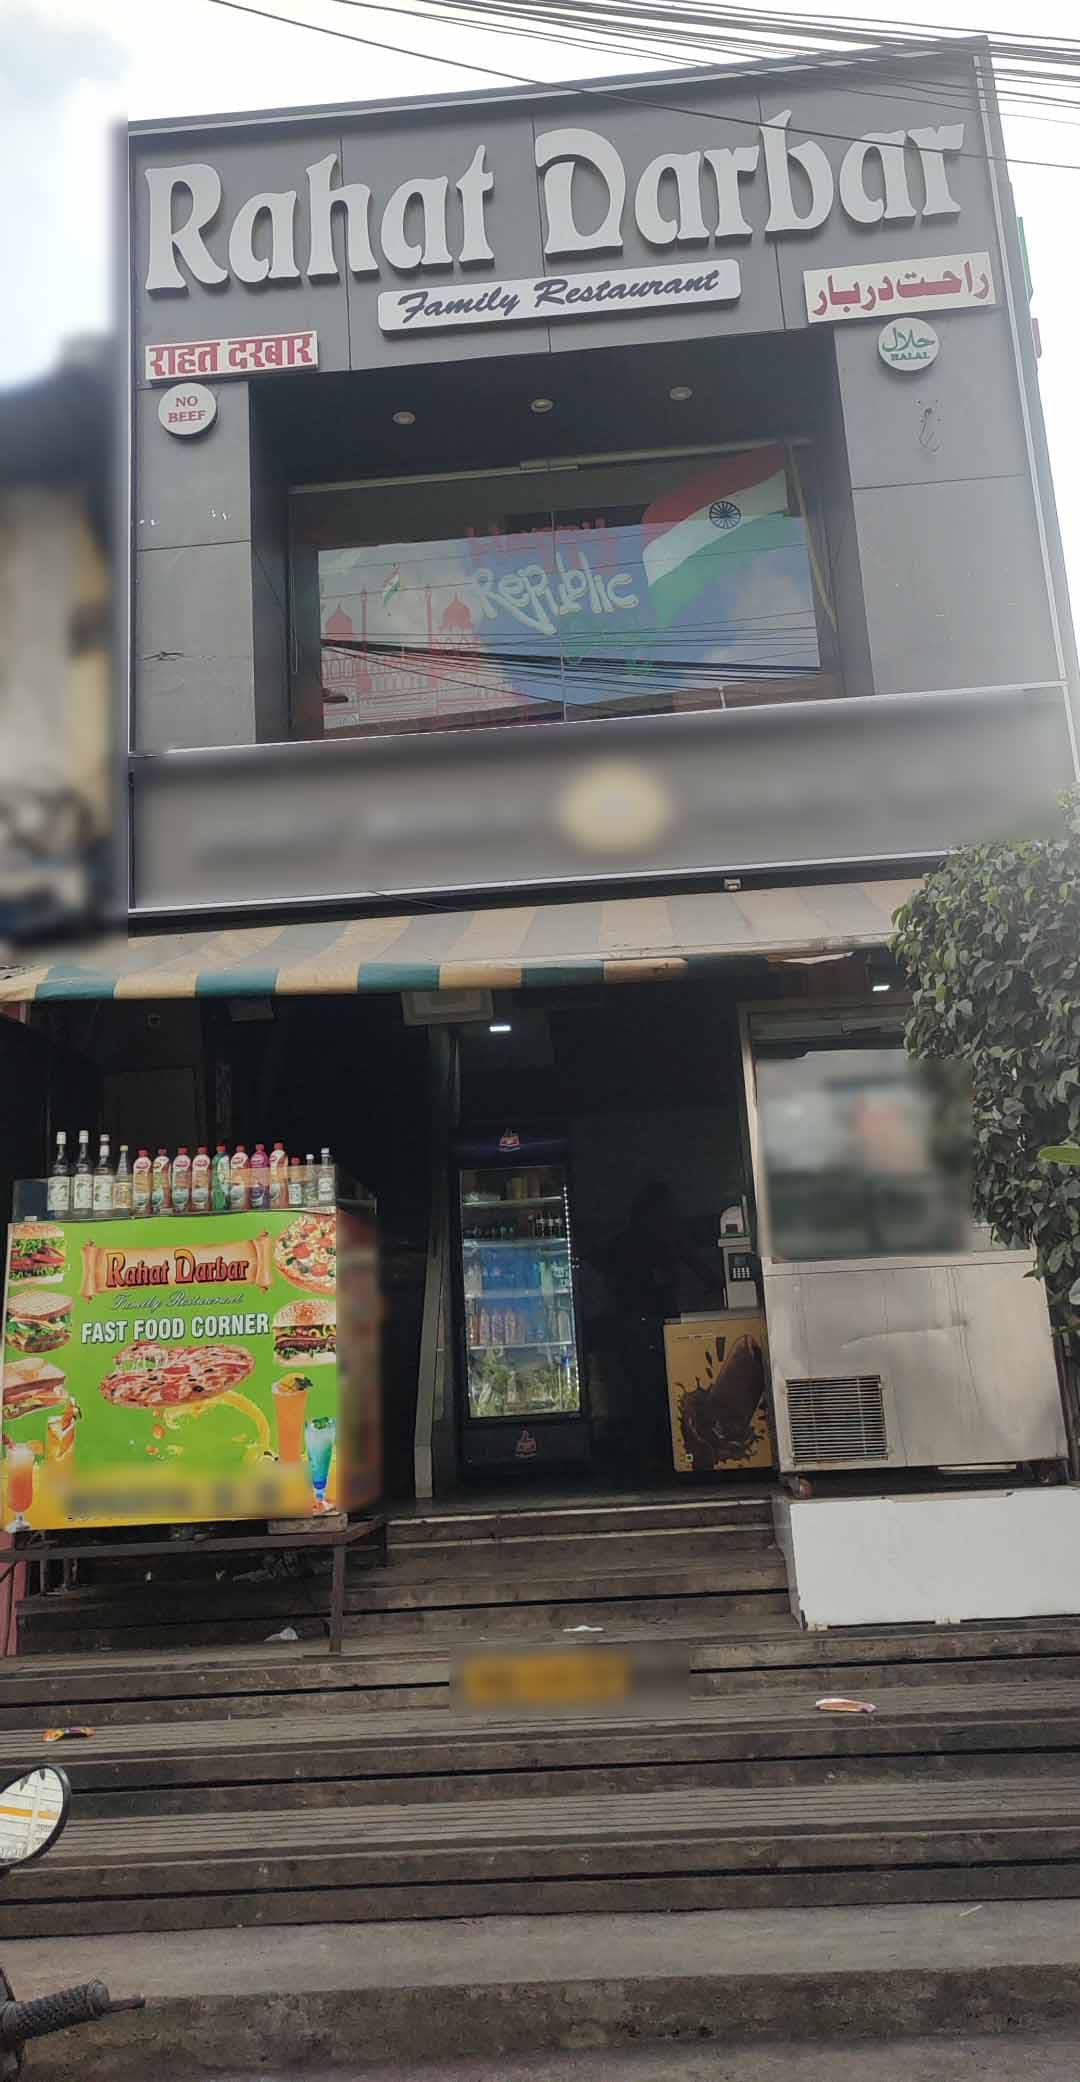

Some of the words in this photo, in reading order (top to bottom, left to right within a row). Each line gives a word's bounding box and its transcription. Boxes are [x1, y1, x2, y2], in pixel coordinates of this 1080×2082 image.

[144, 144, 496, 292] Rahat
[534, 109, 966, 254] Darbar
[397, 287, 520, 323] Family
[534, 269, 719, 307] Restaurant
[812, 274, 895, 316] دربار
[894, 260, 990, 300] راحت
[149, 342, 221, 377] राहत
[228, 334, 314, 369] दरबार
[882, 327, 937, 352] حلال
[168, 410, 207, 424] BEEF
[175, 395, 199, 408] NO
[107, 1251, 170, 1288] Rahat
[174, 1249, 250, 1284] Darbar
[81, 1321, 128, 1345] FAST
[134, 1317, 185, 1340] FOOD
[191, 1313, 271, 1337] CORNER
